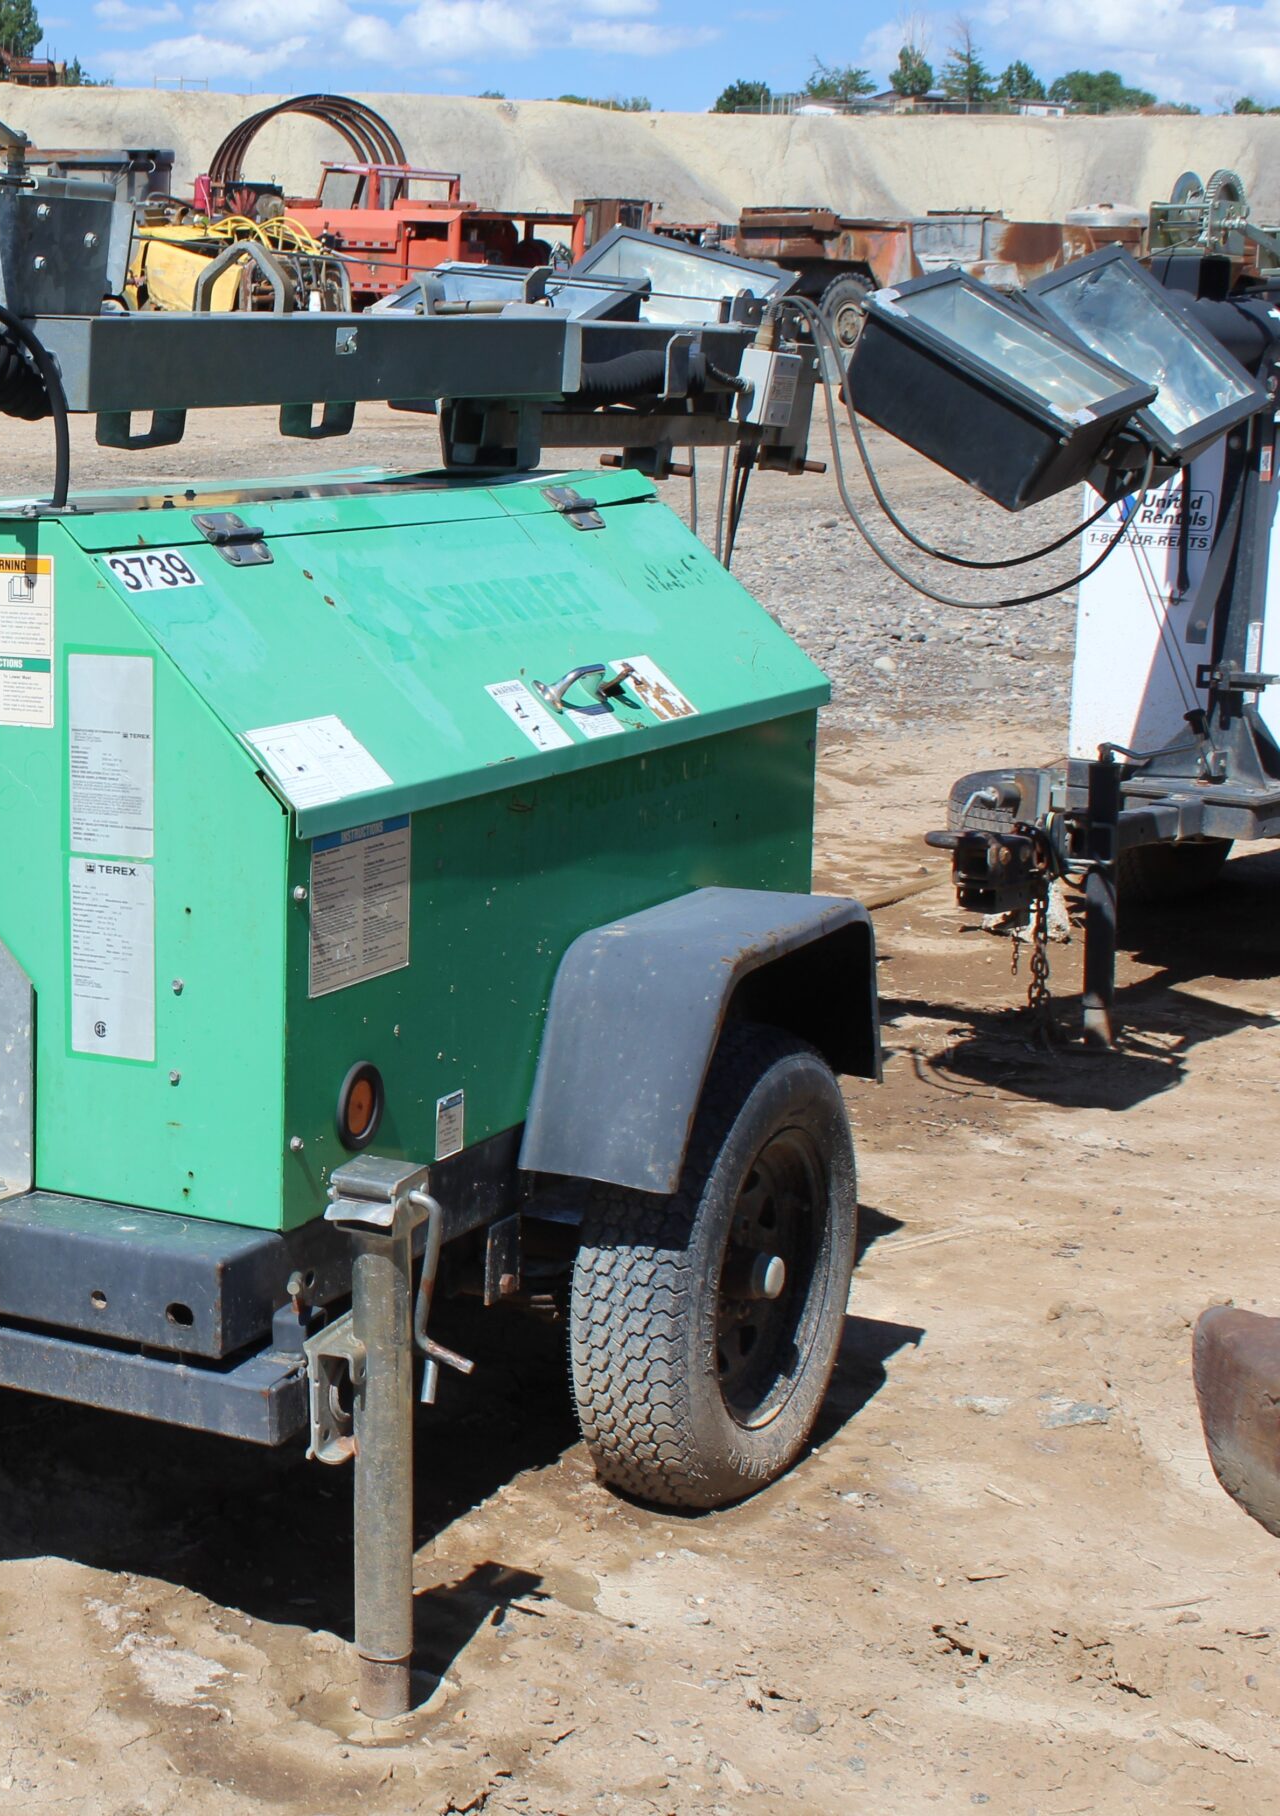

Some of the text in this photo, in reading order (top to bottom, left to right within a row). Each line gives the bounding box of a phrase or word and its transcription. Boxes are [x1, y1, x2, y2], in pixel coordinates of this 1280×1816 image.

[1142, 494, 1202, 510] Unitd
[1141, 510, 1207, 526] Rentls
[1089, 533, 1208, 549] 1-800-UR-RETS
[109, 553, 196, 591] 3739
[424, 571, 603, 631] SUNBELT
[341, 821, 384, 844] INSTRUCTIONS
[98, 864, 137, 877] TEREX
